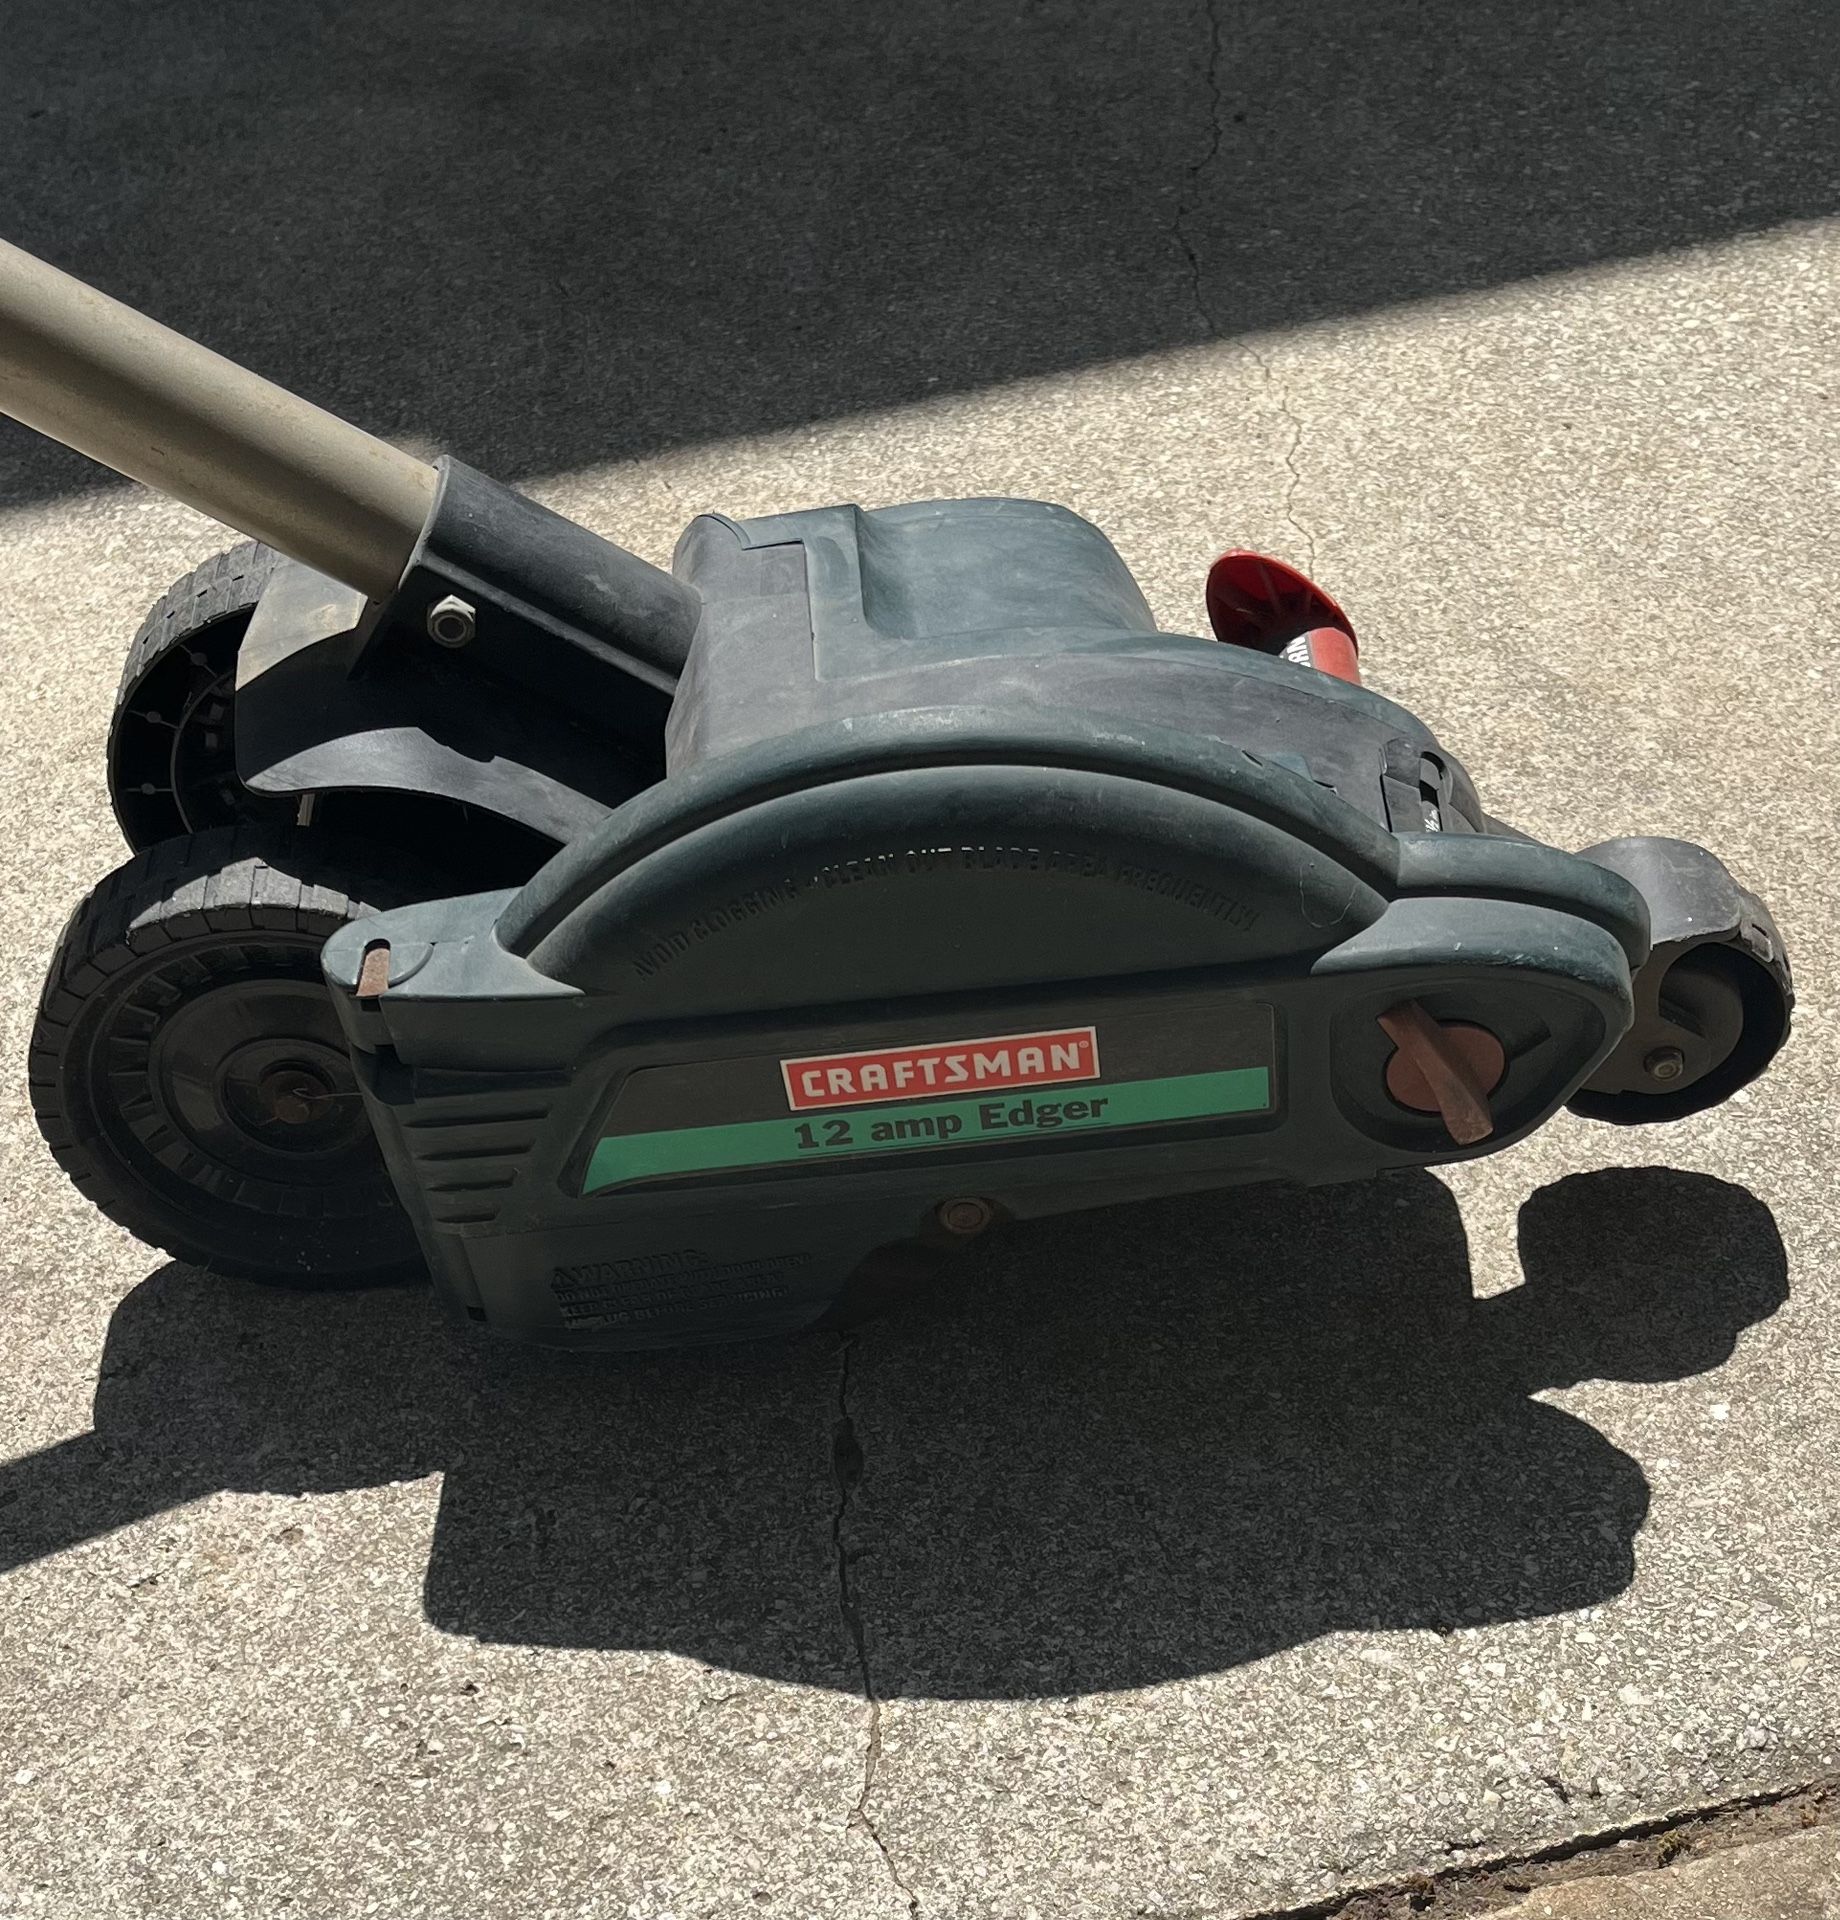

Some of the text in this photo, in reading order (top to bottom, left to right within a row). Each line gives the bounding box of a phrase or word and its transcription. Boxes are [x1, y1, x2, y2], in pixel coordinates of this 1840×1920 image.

[801, 1041, 1089, 1097] CRAFTSMAN
[794, 1098, 1109, 1149] 12 amp Edger
